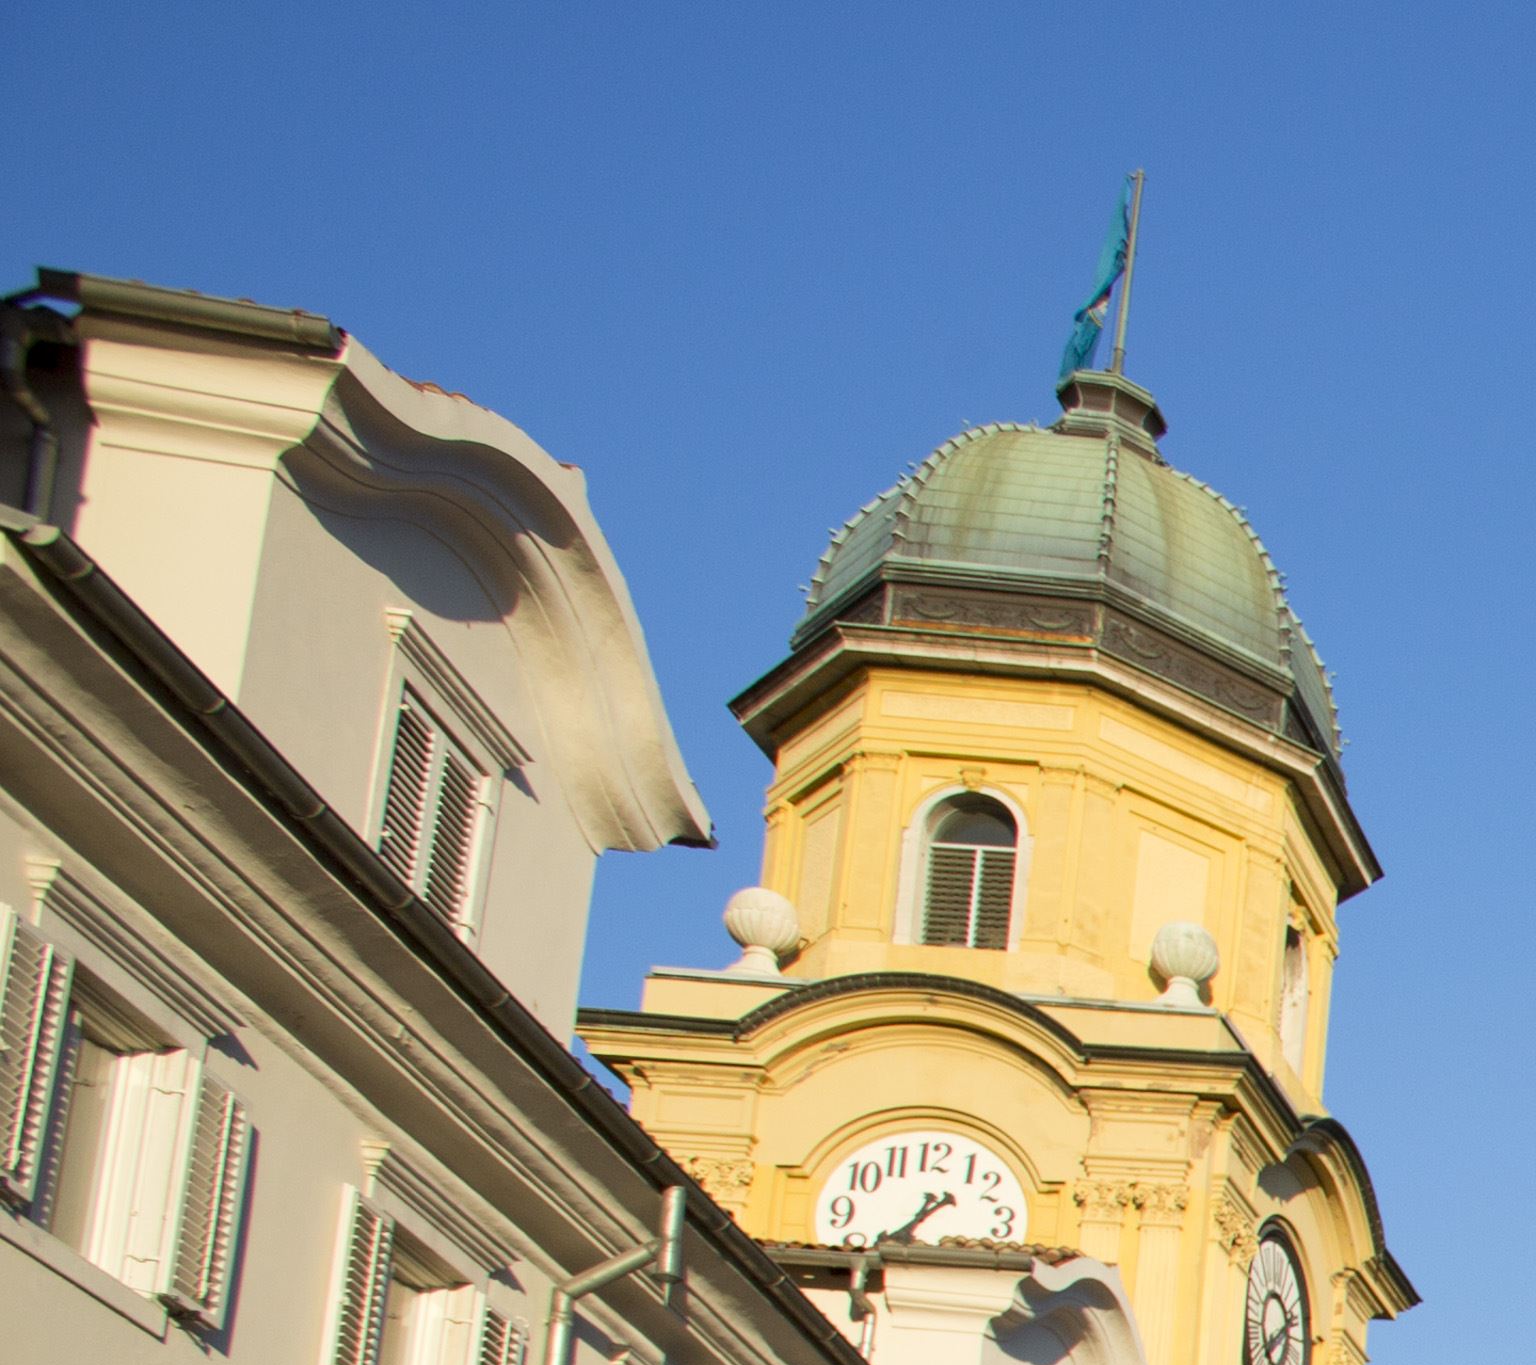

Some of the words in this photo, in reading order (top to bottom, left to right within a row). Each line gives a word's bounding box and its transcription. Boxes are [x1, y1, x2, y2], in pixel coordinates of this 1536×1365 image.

[885, 1146, 909, 1178] 11
[918, 1142, 953, 1174] 12
[964, 1153, 977, 1184] 1
[849, 1161, 883, 1193] 10
[980, 1171, 1002, 1203] 2
[829, 1195, 856, 1229] 9
[991, 1206, 1016, 1239] 3
